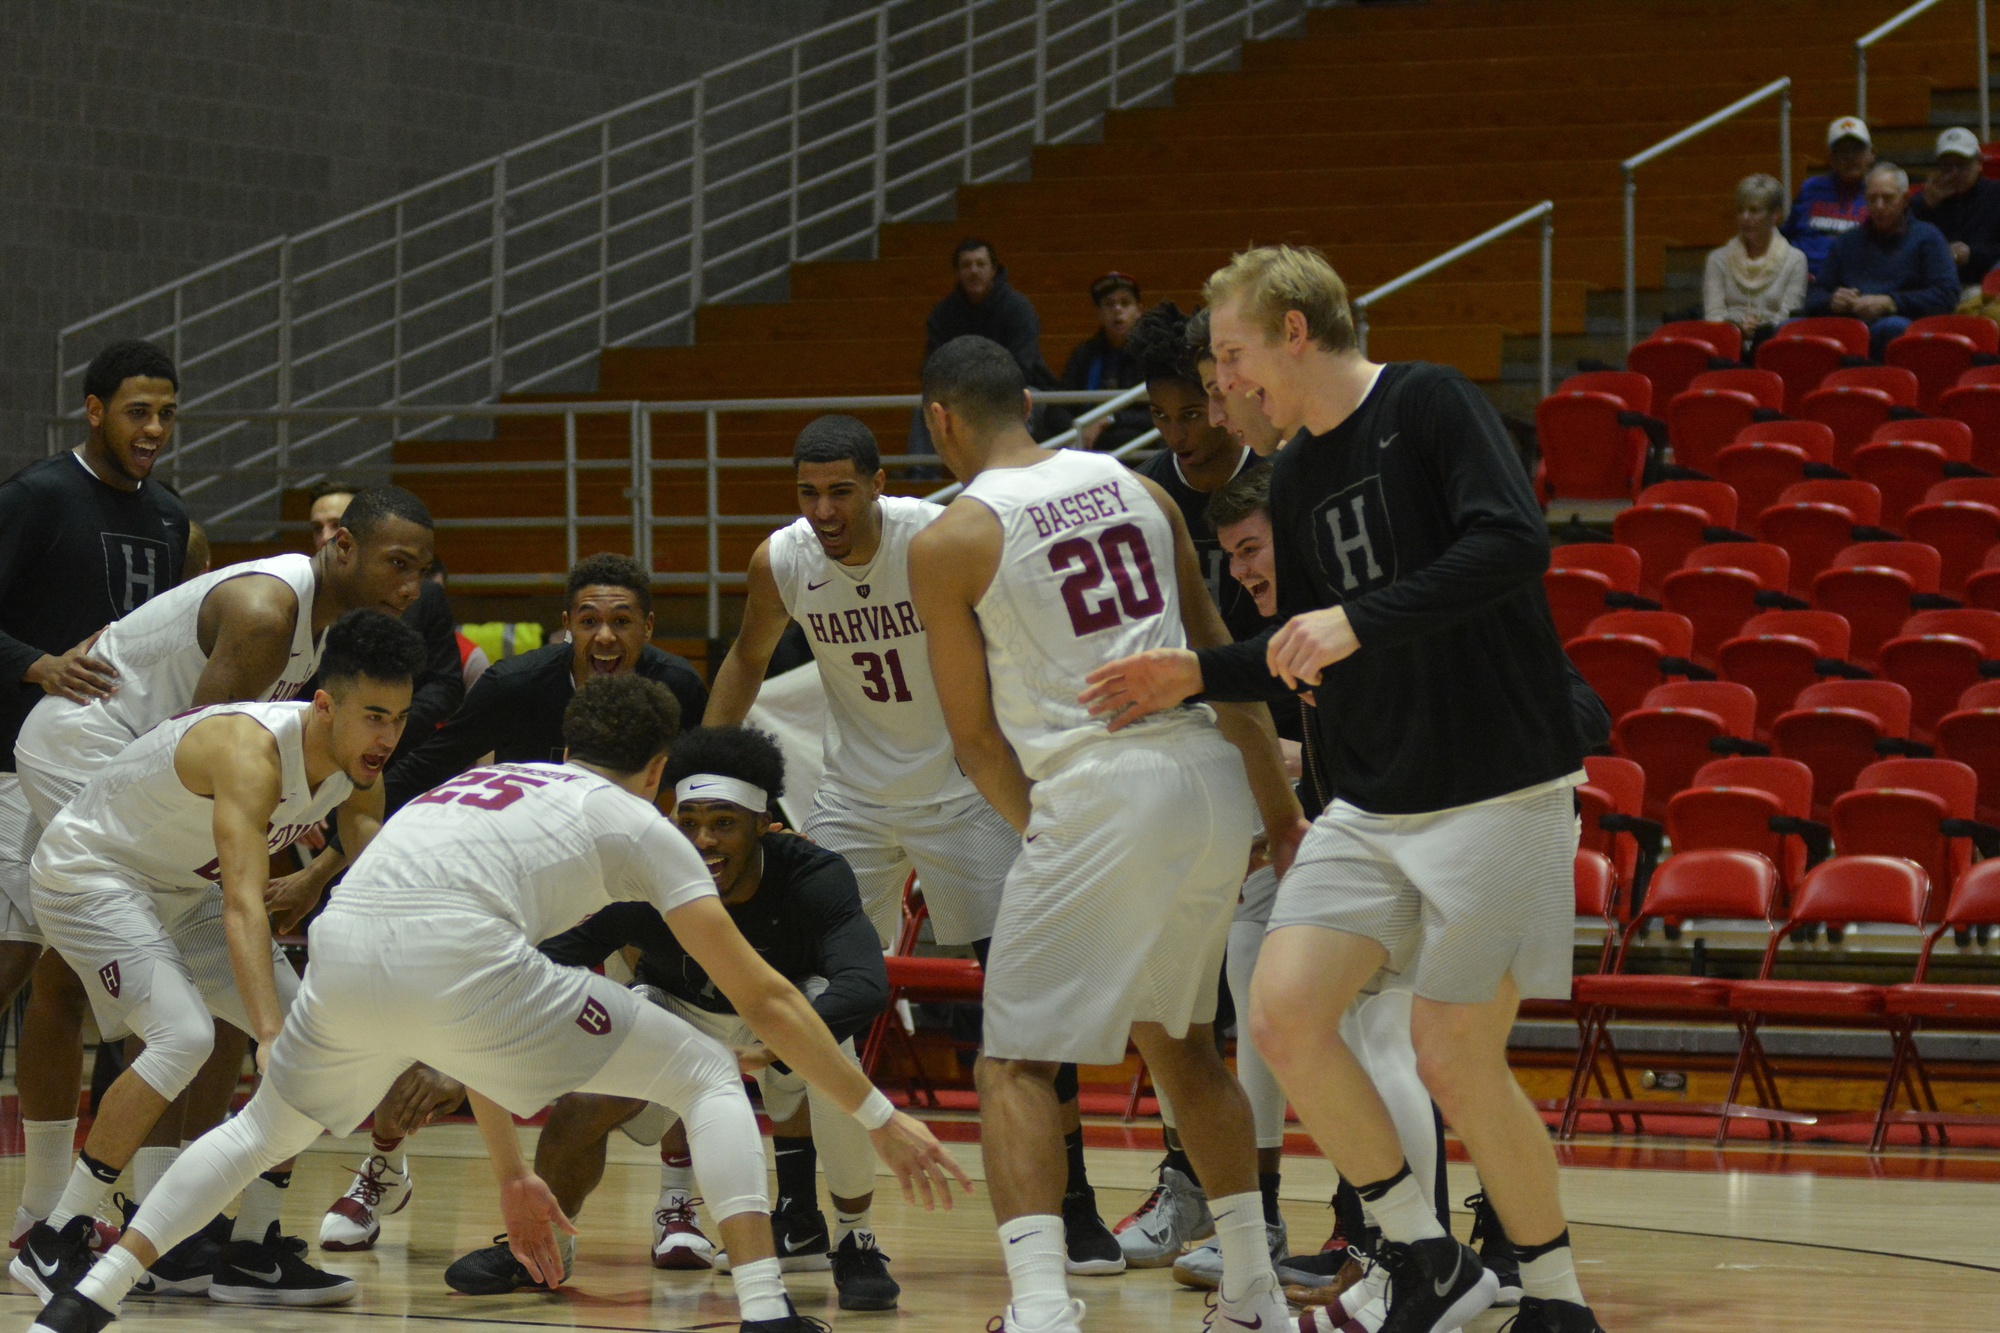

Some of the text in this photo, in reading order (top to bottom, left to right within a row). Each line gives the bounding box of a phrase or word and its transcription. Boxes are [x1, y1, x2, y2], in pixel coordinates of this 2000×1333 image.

[1027, 481, 1128, 538] BASSEY
[1326, 495, 1384, 590] H
[121, 544, 156, 611] H
[1047, 522, 1165, 637] 20
[807, 600, 926, 644] HARVAR
[851, 649, 912, 703] 31
[407, 772, 549, 811] 25
[102, 966, 118, 991] H
[582, 1003, 607, 1031] H
